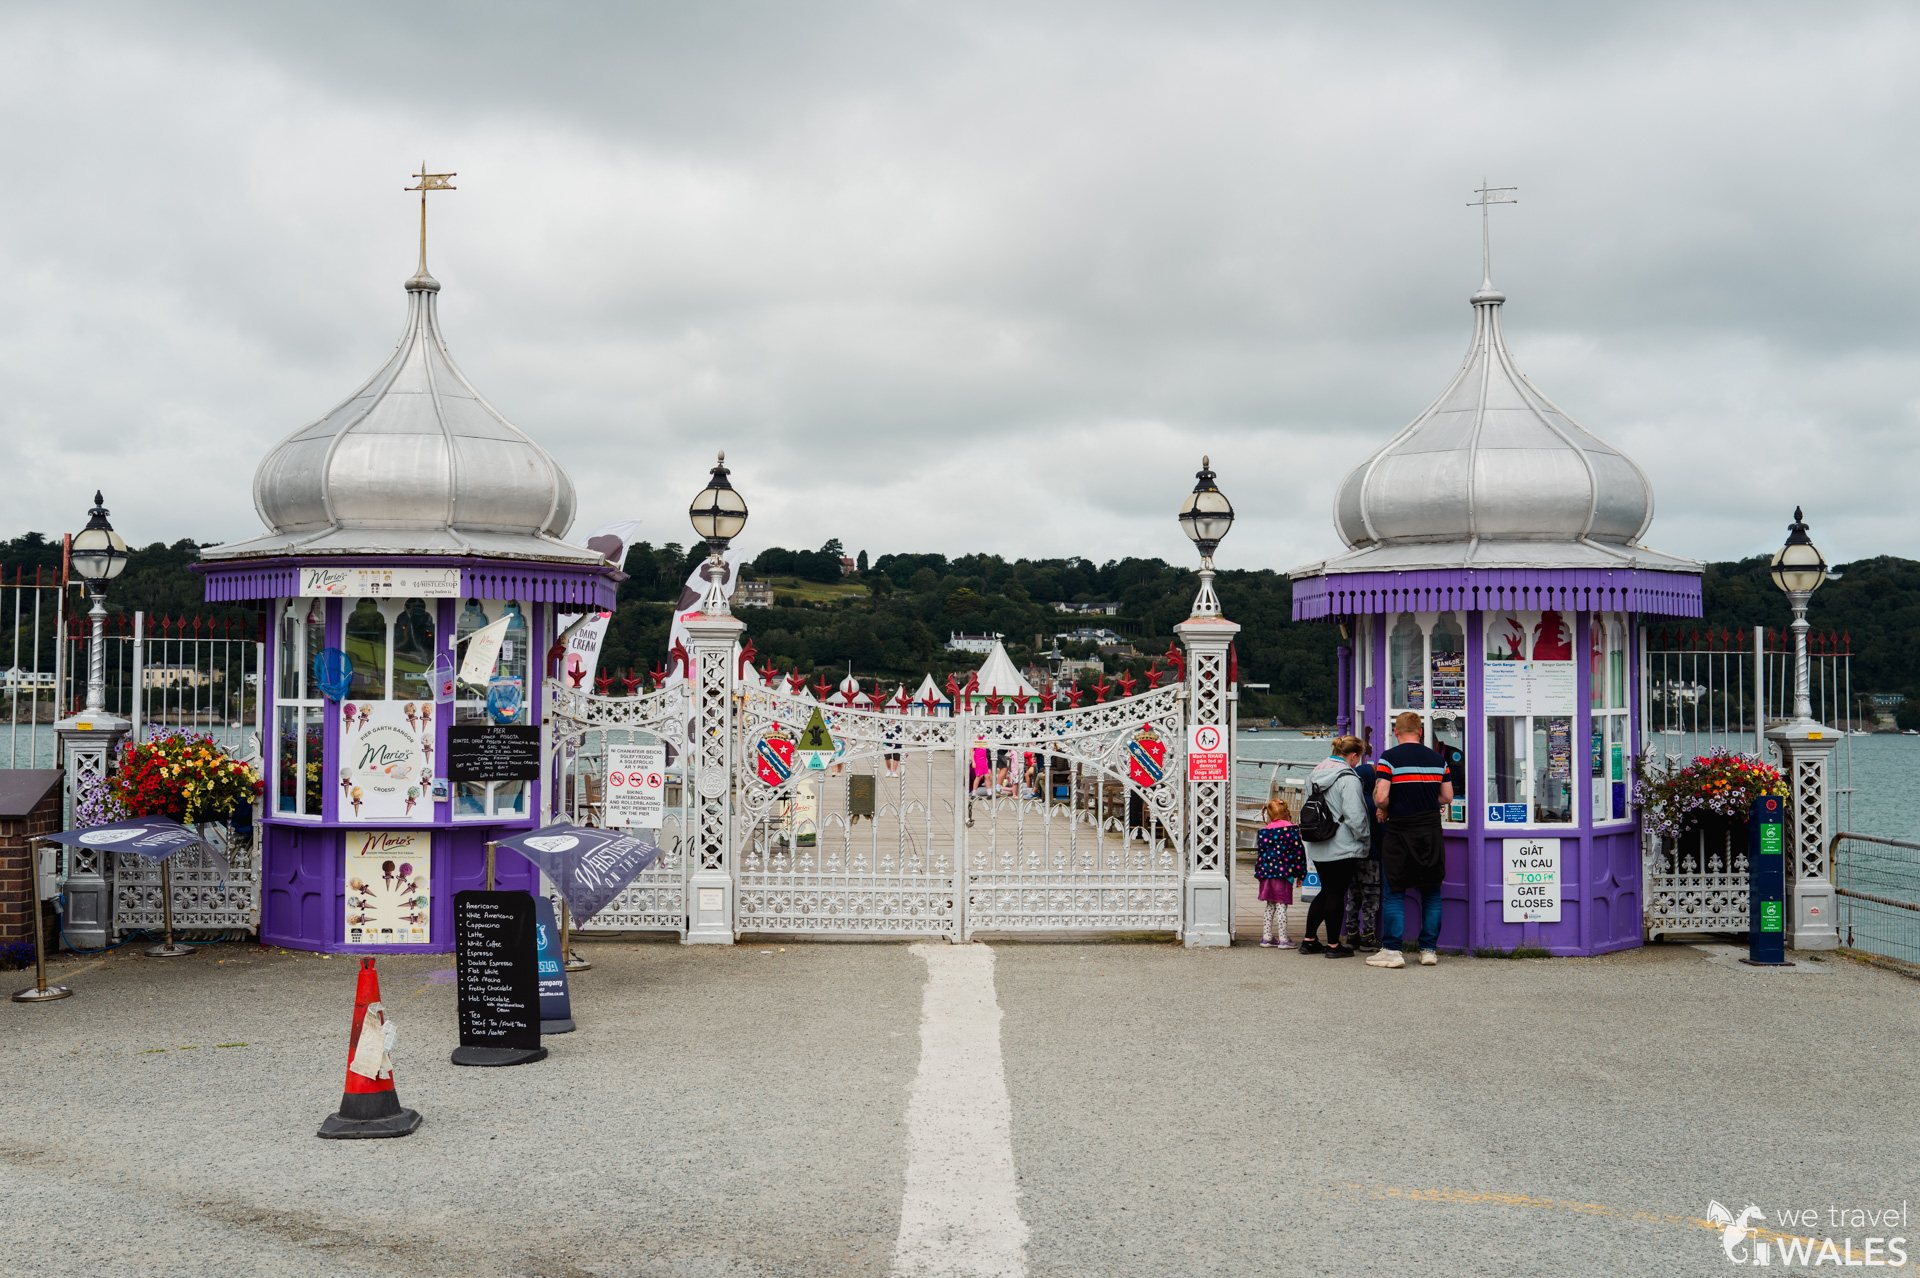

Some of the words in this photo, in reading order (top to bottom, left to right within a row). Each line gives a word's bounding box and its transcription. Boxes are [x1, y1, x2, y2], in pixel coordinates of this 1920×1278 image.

[307, 569, 348, 589] Mario's
[413, 581, 458, 589] WHISTLESTOP
[579, 628, 598, 641] DAIRY
[572, 638, 597, 652] CREAM
[360, 730, 372, 741] PIER
[393, 726, 415, 743] BANGOR
[358, 743, 414, 770] Mario's
[361, 832, 415, 855] Mario's
[1520, 845, 1543, 855] GIÂT
[1531, 859, 1552, 867] CAU
[604, 872, 621, 888] ON
[619, 855, 638, 872] THE
[1516, 874, 1542, 883] 7:00
[1518, 887, 1545, 895] GATE
[466, 902, 499, 910] Americano
[1511, 899, 1554, 908] CLOSES
[466, 920, 500, 930] Cappuccino
[467, 949, 493, 957] Espresso
